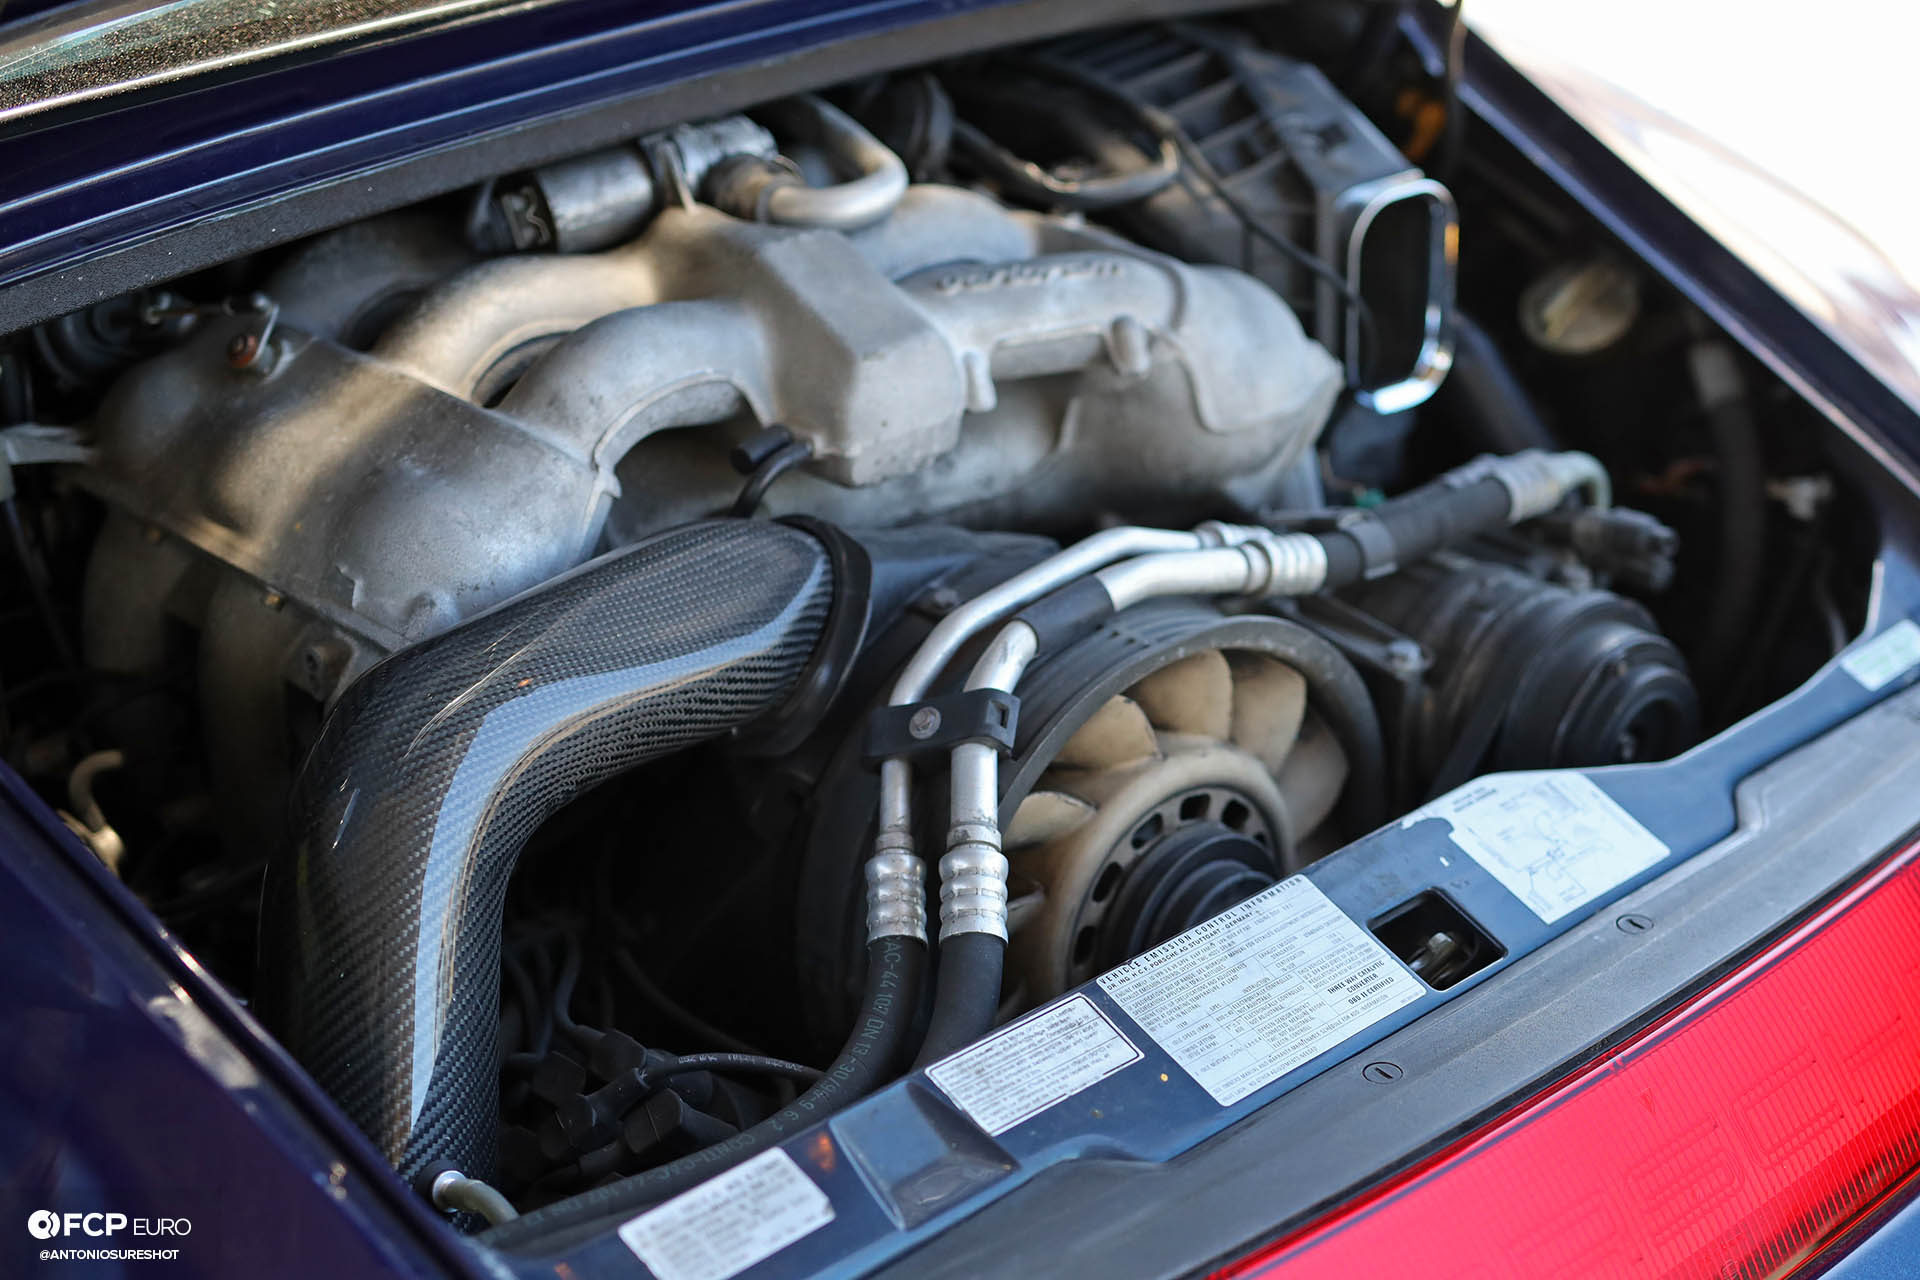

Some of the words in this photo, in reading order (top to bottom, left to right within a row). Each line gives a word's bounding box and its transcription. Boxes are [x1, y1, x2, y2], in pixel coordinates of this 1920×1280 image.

[1097, 959, 1143, 986] VEHICLE
[1141, 933, 1193, 963] EMISSION
[1192, 909, 1238, 936] CONTROL
[1237, 875, 1303, 912] INFORMATION
[1148, 949, 1180, 969] PORSCHE
[1186, 927, 1222, 948] STUTTGART
[1222, 910, 1254, 929] GERMANY
[1325, 980, 1347, 995] THREE
[1343, 973, 1359, 985] WAY
[1355, 959, 1386, 978] CATALYTIC
[1345, 972, 1379, 993] CONVERTER
[1346, 994, 1363, 1005] OBD
[1358, 990, 1369, 998] II
[1364, 975, 1396, 995] CERTIFIED
[860, 1017, 886, 1041] DN
